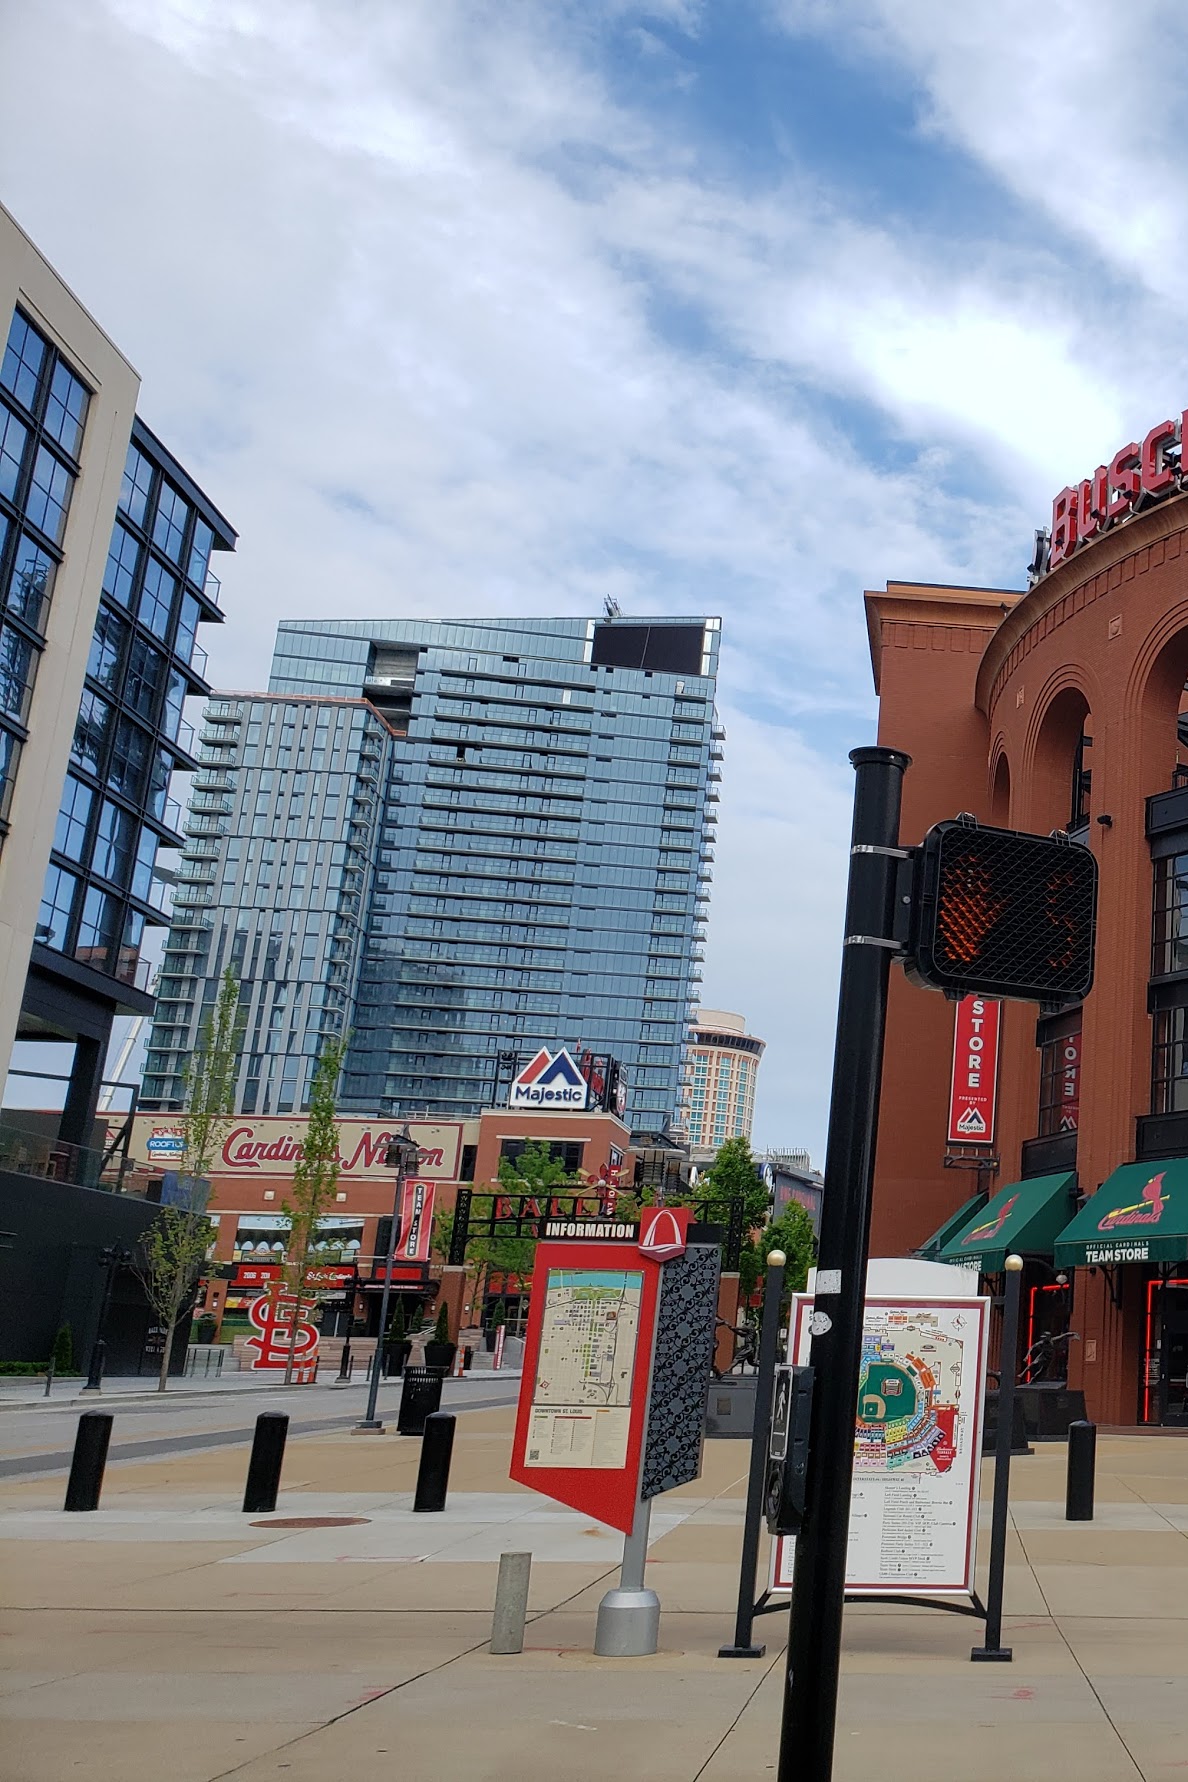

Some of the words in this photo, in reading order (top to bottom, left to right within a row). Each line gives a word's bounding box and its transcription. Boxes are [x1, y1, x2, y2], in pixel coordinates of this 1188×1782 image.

[967, 1000, 985, 1088] STORE
[515, 1086, 583, 1104] Majestic
[958, 1123, 984, 1134] Majestic
[415, 1186, 423, 1215] TEAM
[1097, 1207, 1162, 1231] Cardinals
[408, 1218, 418, 1255] STORE
[545, 1222, 635, 1238] INFORMATION
[1115, 1240, 1149, 1248] CARDINALS
[1085, 1250, 1113, 1263] TEAM
[1114, 1247, 1149, 1261] STORE
